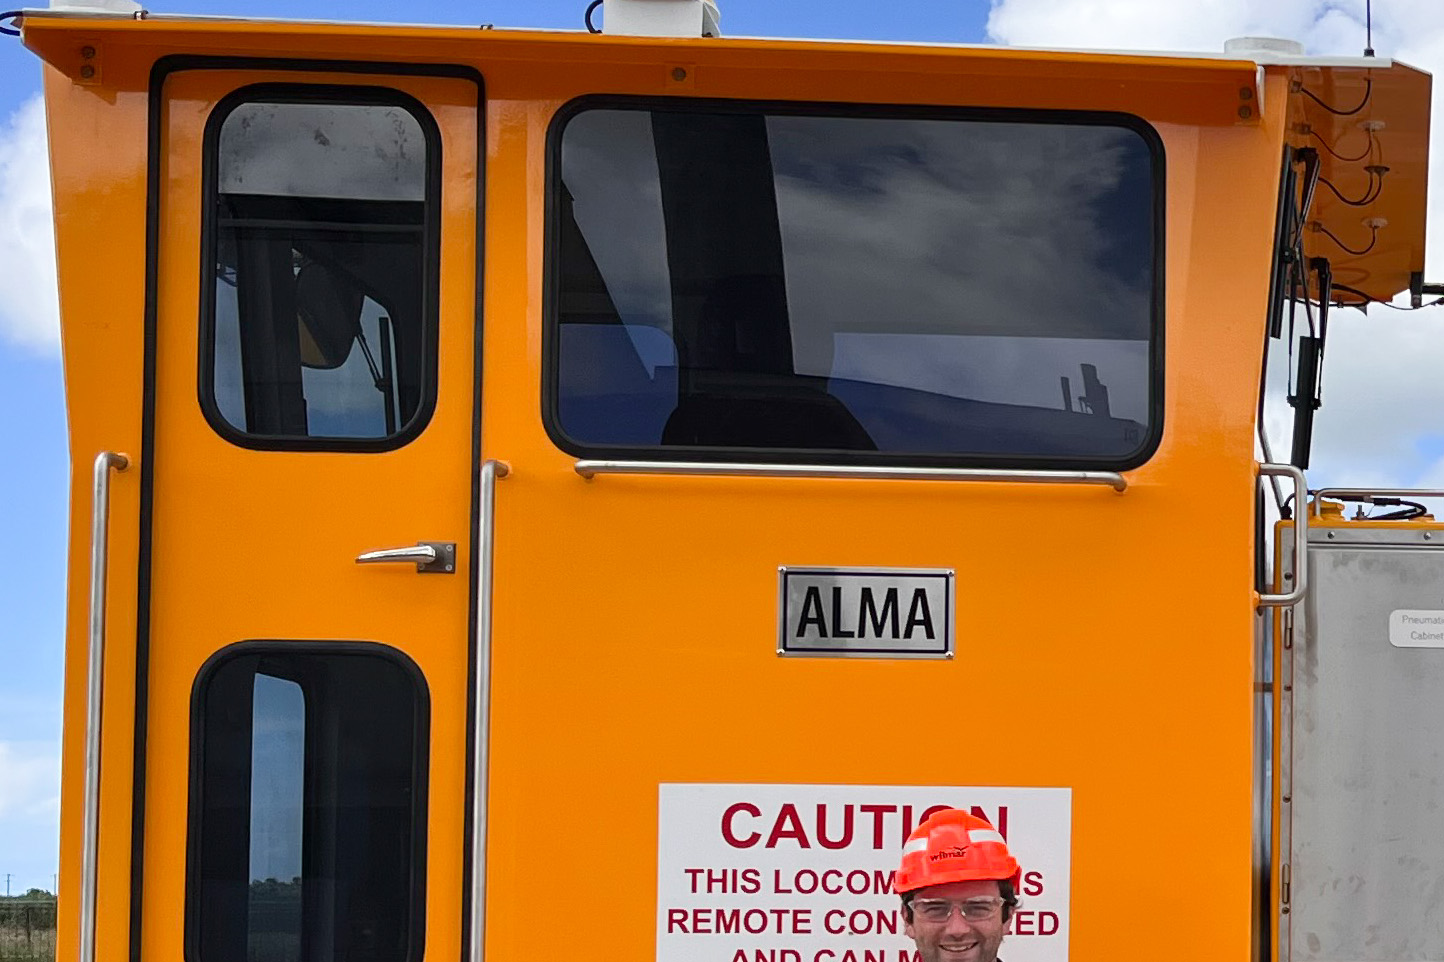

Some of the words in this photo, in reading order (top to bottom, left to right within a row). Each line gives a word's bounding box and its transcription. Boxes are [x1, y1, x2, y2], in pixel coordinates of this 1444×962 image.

[795, 585, 936, 640] ALMA
[1410, 630, 1444, 641] Cabinet
[721, 802, 1008, 850] CAUTIN
[685, 868, 761, 894] THIS
[667, 908, 812, 934] REMOTE
